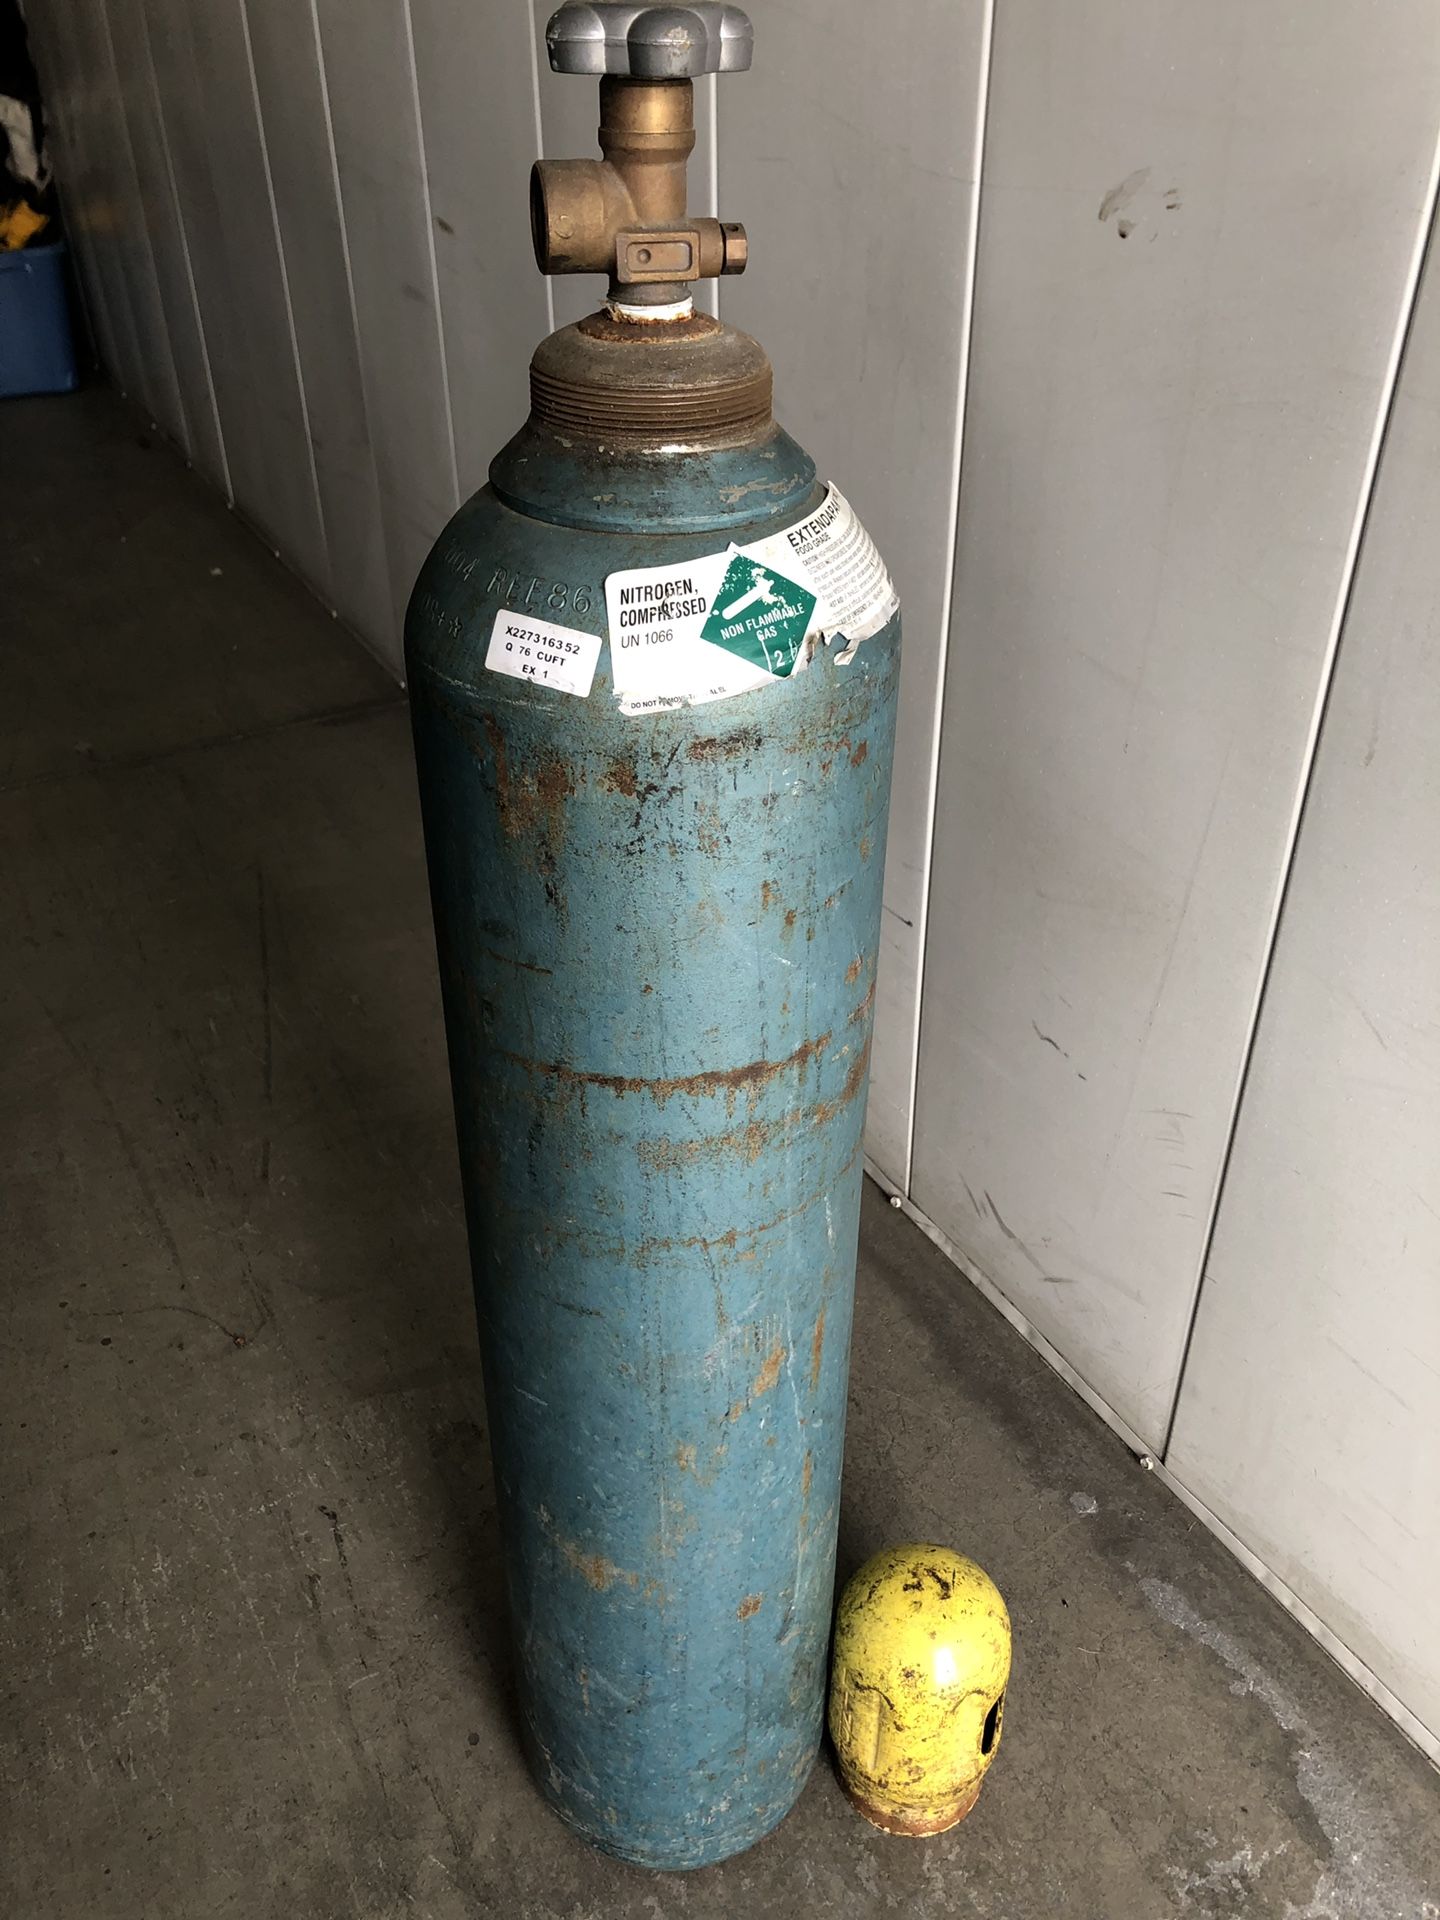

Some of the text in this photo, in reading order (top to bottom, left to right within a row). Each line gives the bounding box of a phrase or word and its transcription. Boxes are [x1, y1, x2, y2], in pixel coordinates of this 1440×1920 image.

[794, 532, 832, 557] FOOD GRADE
[620, 578, 698, 605] NITROGEN,
[720, 603, 805, 640] NON FLAMMABLE
[756, 626, 778, 641] GAS
[505, 625, 580, 655] X227316352
[621, 628, 673, 648] UN 1066
[505, 642, 566, 666] Q 76 CUFT
[522, 664, 549, 678] EX 1
[642, 700, 657, 708] NOT
